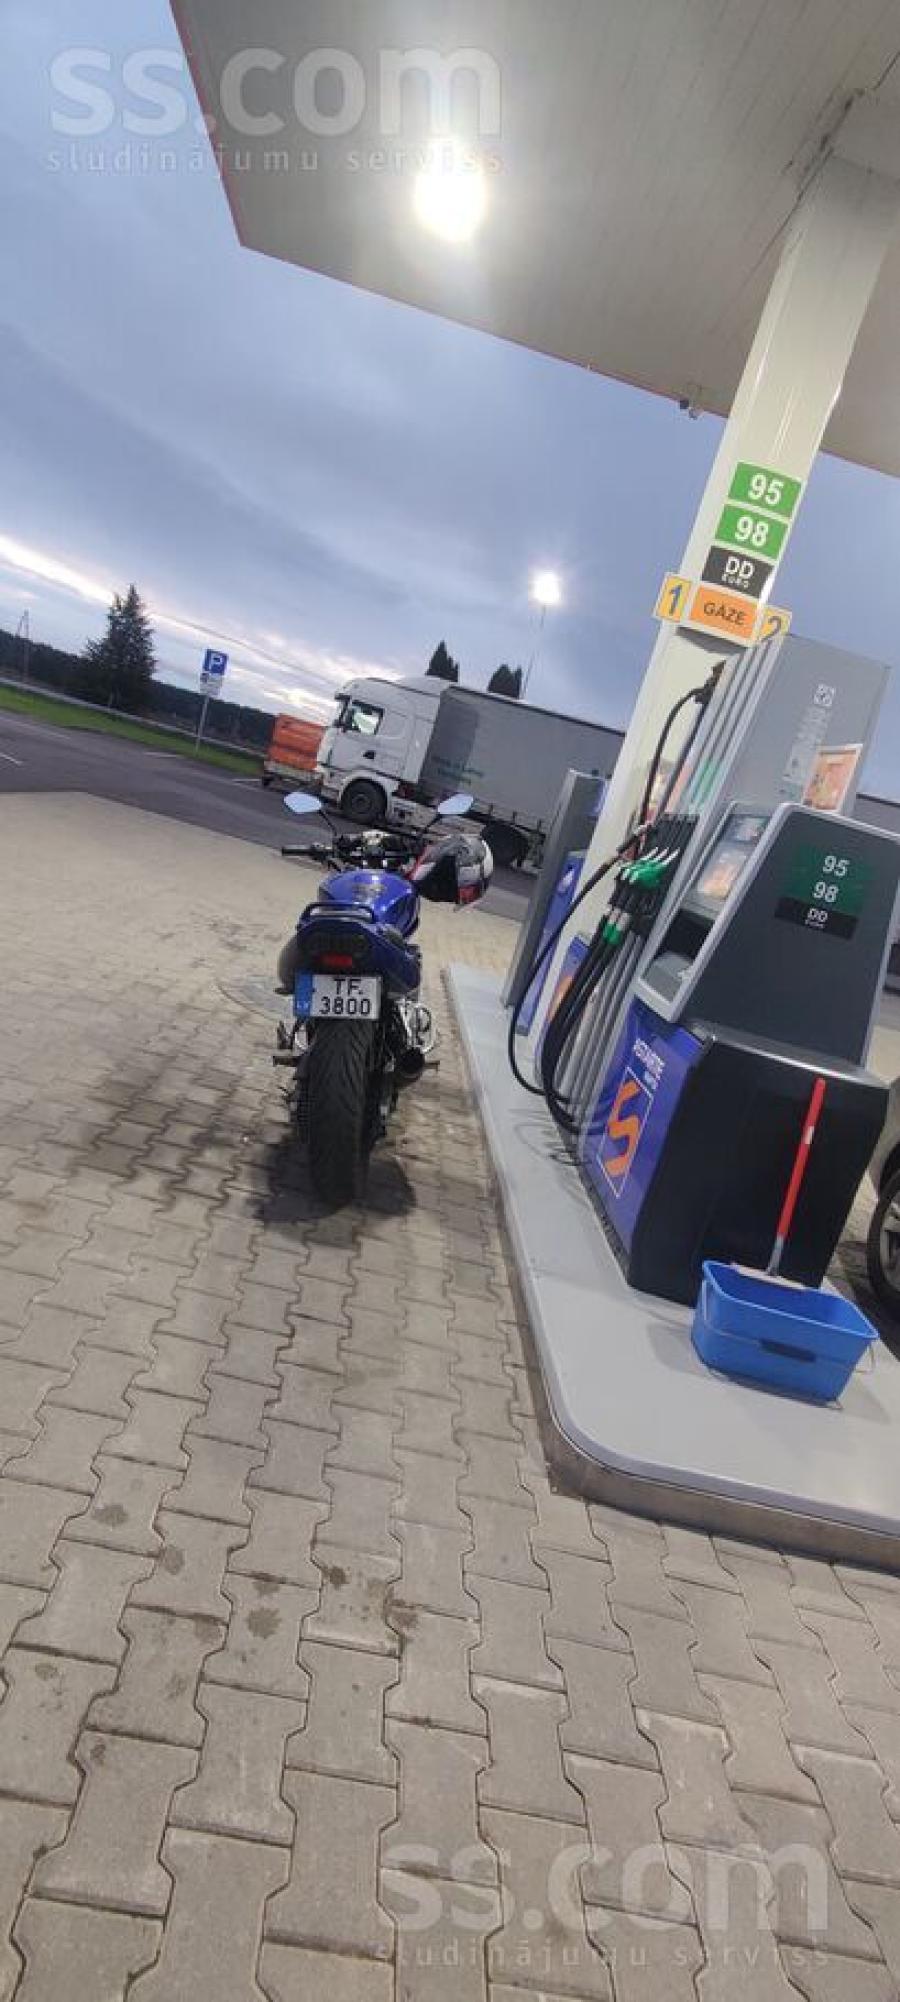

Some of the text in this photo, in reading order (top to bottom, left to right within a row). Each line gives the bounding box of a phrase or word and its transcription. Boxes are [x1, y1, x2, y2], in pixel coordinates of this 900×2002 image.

[748, 473, 784, 505] 95
[735, 516, 768, 546] 98
[725, 556, 754, 578] DD
[669, 584, 682, 615] 1
[761, 615, 781, 641] 2
[209, 653, 223, 670] P
[822, 855, 850, 876] 95
[813, 881, 839, 902] 98
[319, 997, 370, 1014] 3800
